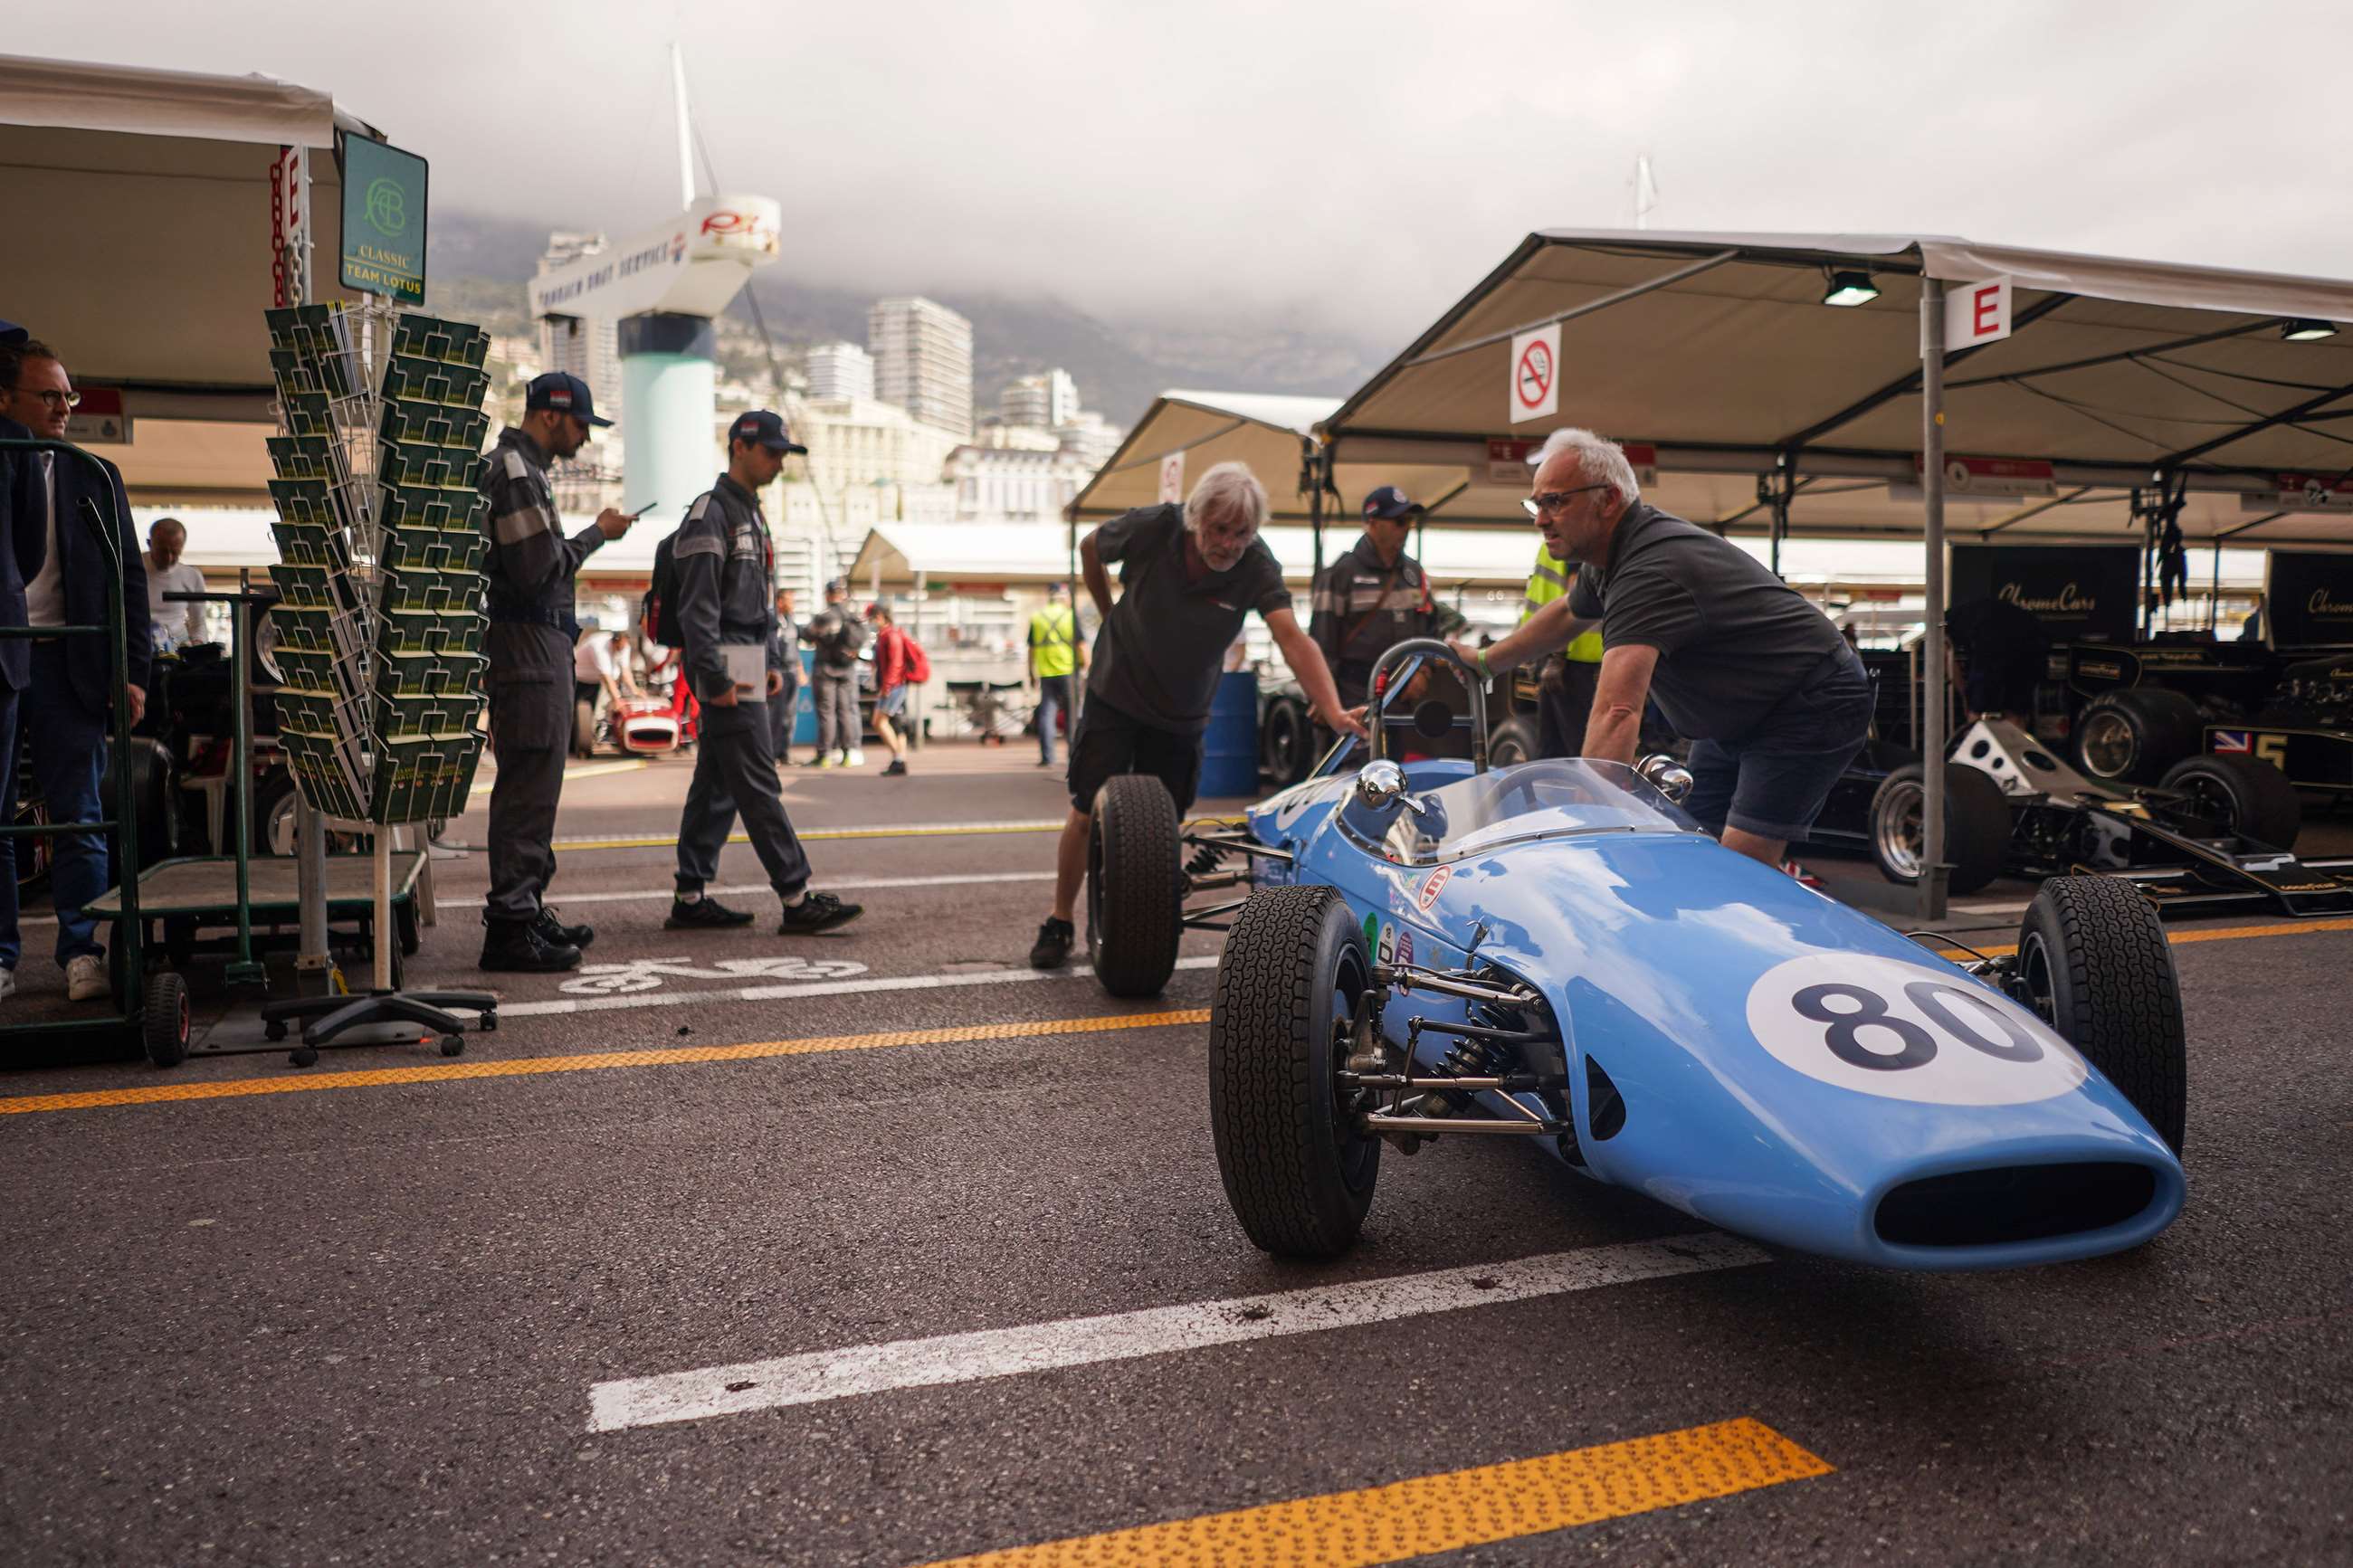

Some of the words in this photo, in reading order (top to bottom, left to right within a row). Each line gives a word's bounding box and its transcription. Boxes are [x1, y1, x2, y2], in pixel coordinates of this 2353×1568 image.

[359, 245, 411, 269] CLASSIC
[347, 262, 380, 283] TEAM
[383, 273, 421, 294] LOTUS
[1974, 285, 1999, 336] E
[1791, 981, 2044, 1071] 80
